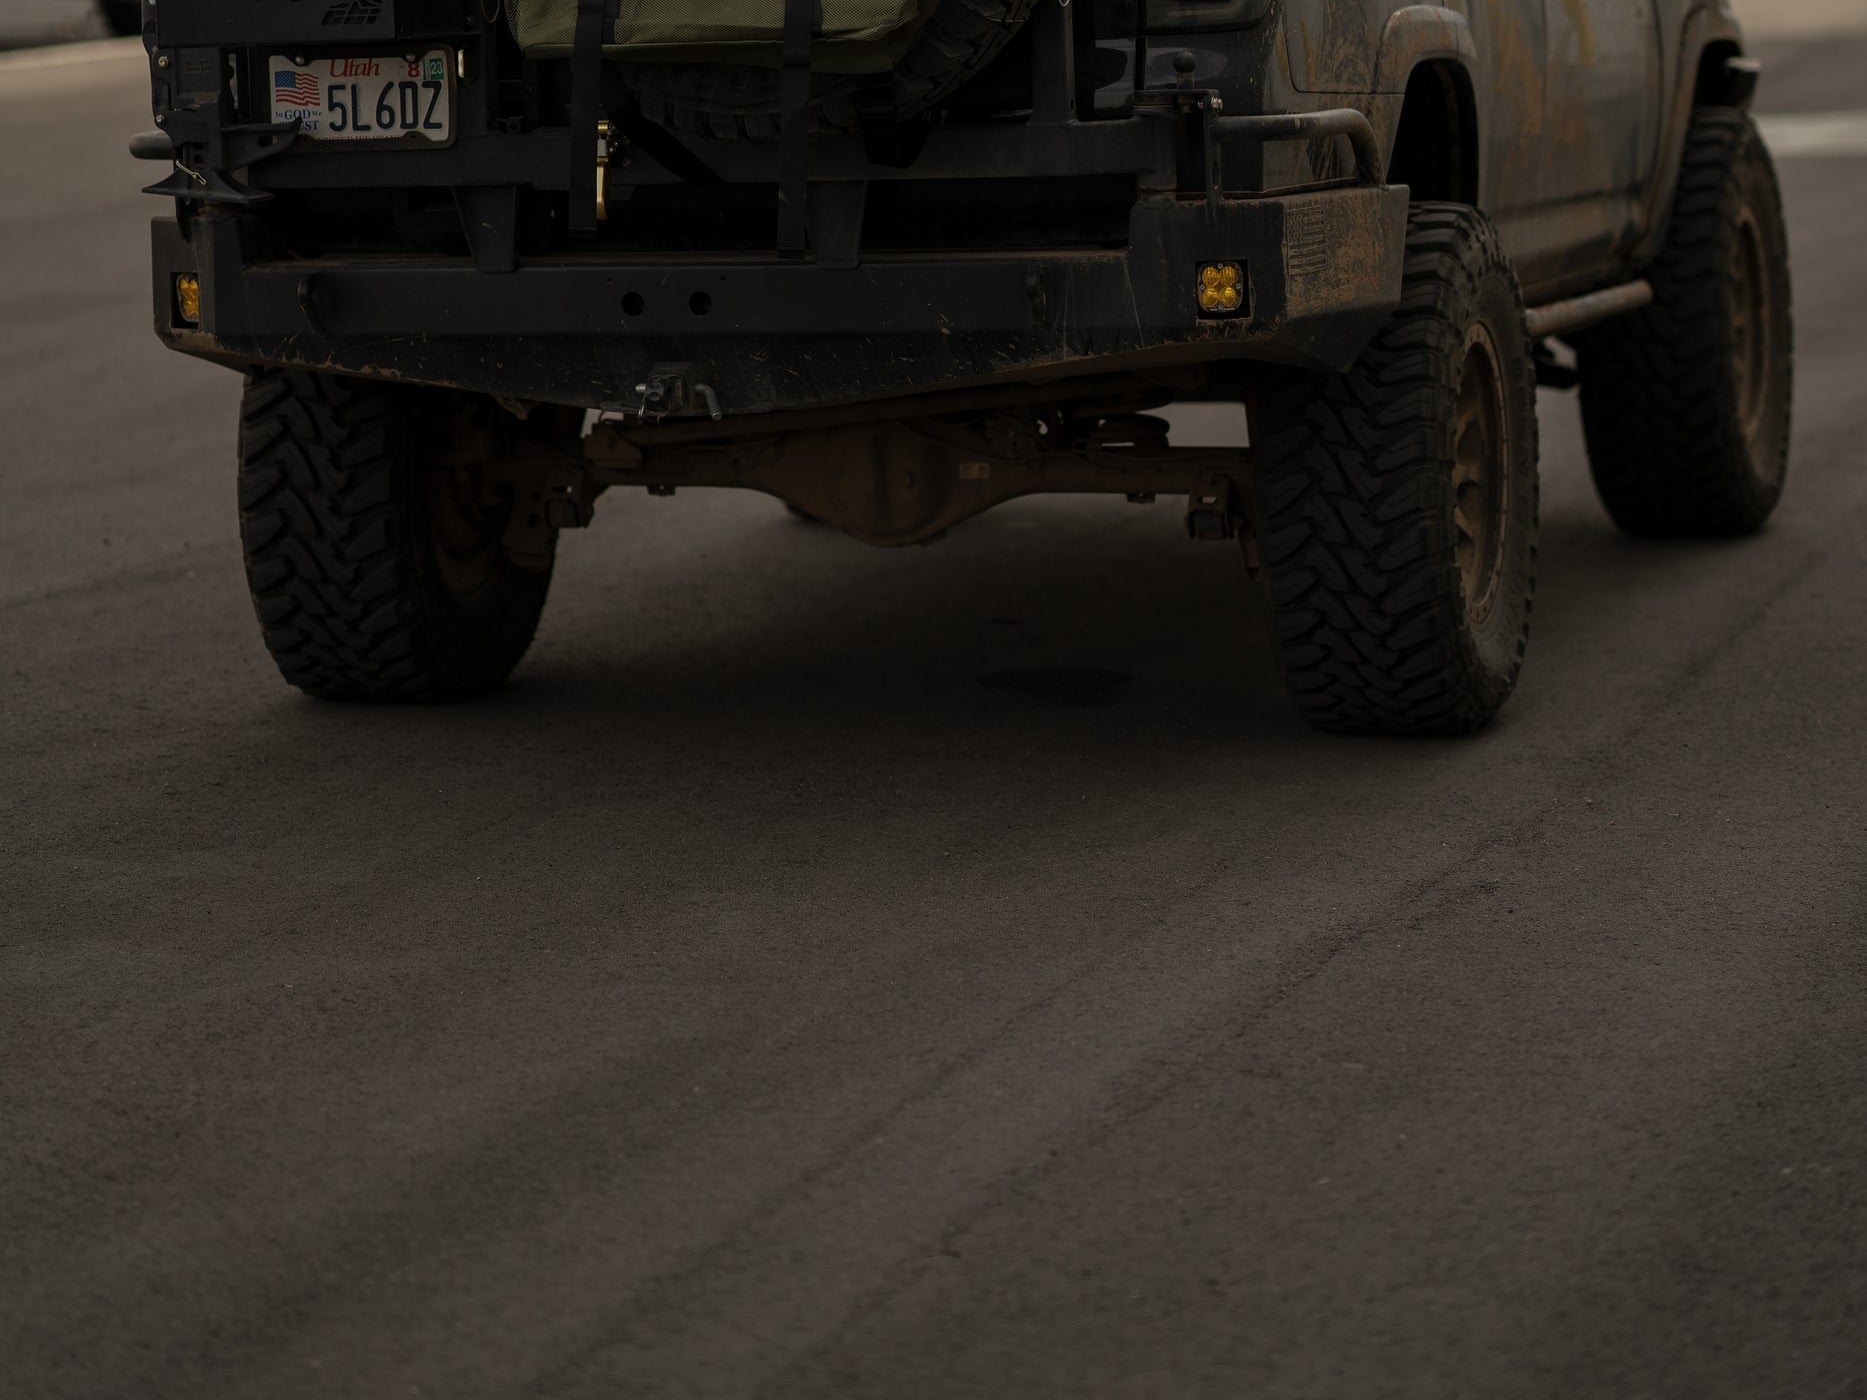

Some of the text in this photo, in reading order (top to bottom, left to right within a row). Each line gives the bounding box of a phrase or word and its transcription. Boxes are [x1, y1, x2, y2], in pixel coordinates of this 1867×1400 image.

[329, 57, 380, 78] Utah
[407, 61, 420, 78] 8
[430, 61, 443, 75] 23
[284, 109, 311, 120] GOD
[327, 80, 443, 132] 5L6DZ
